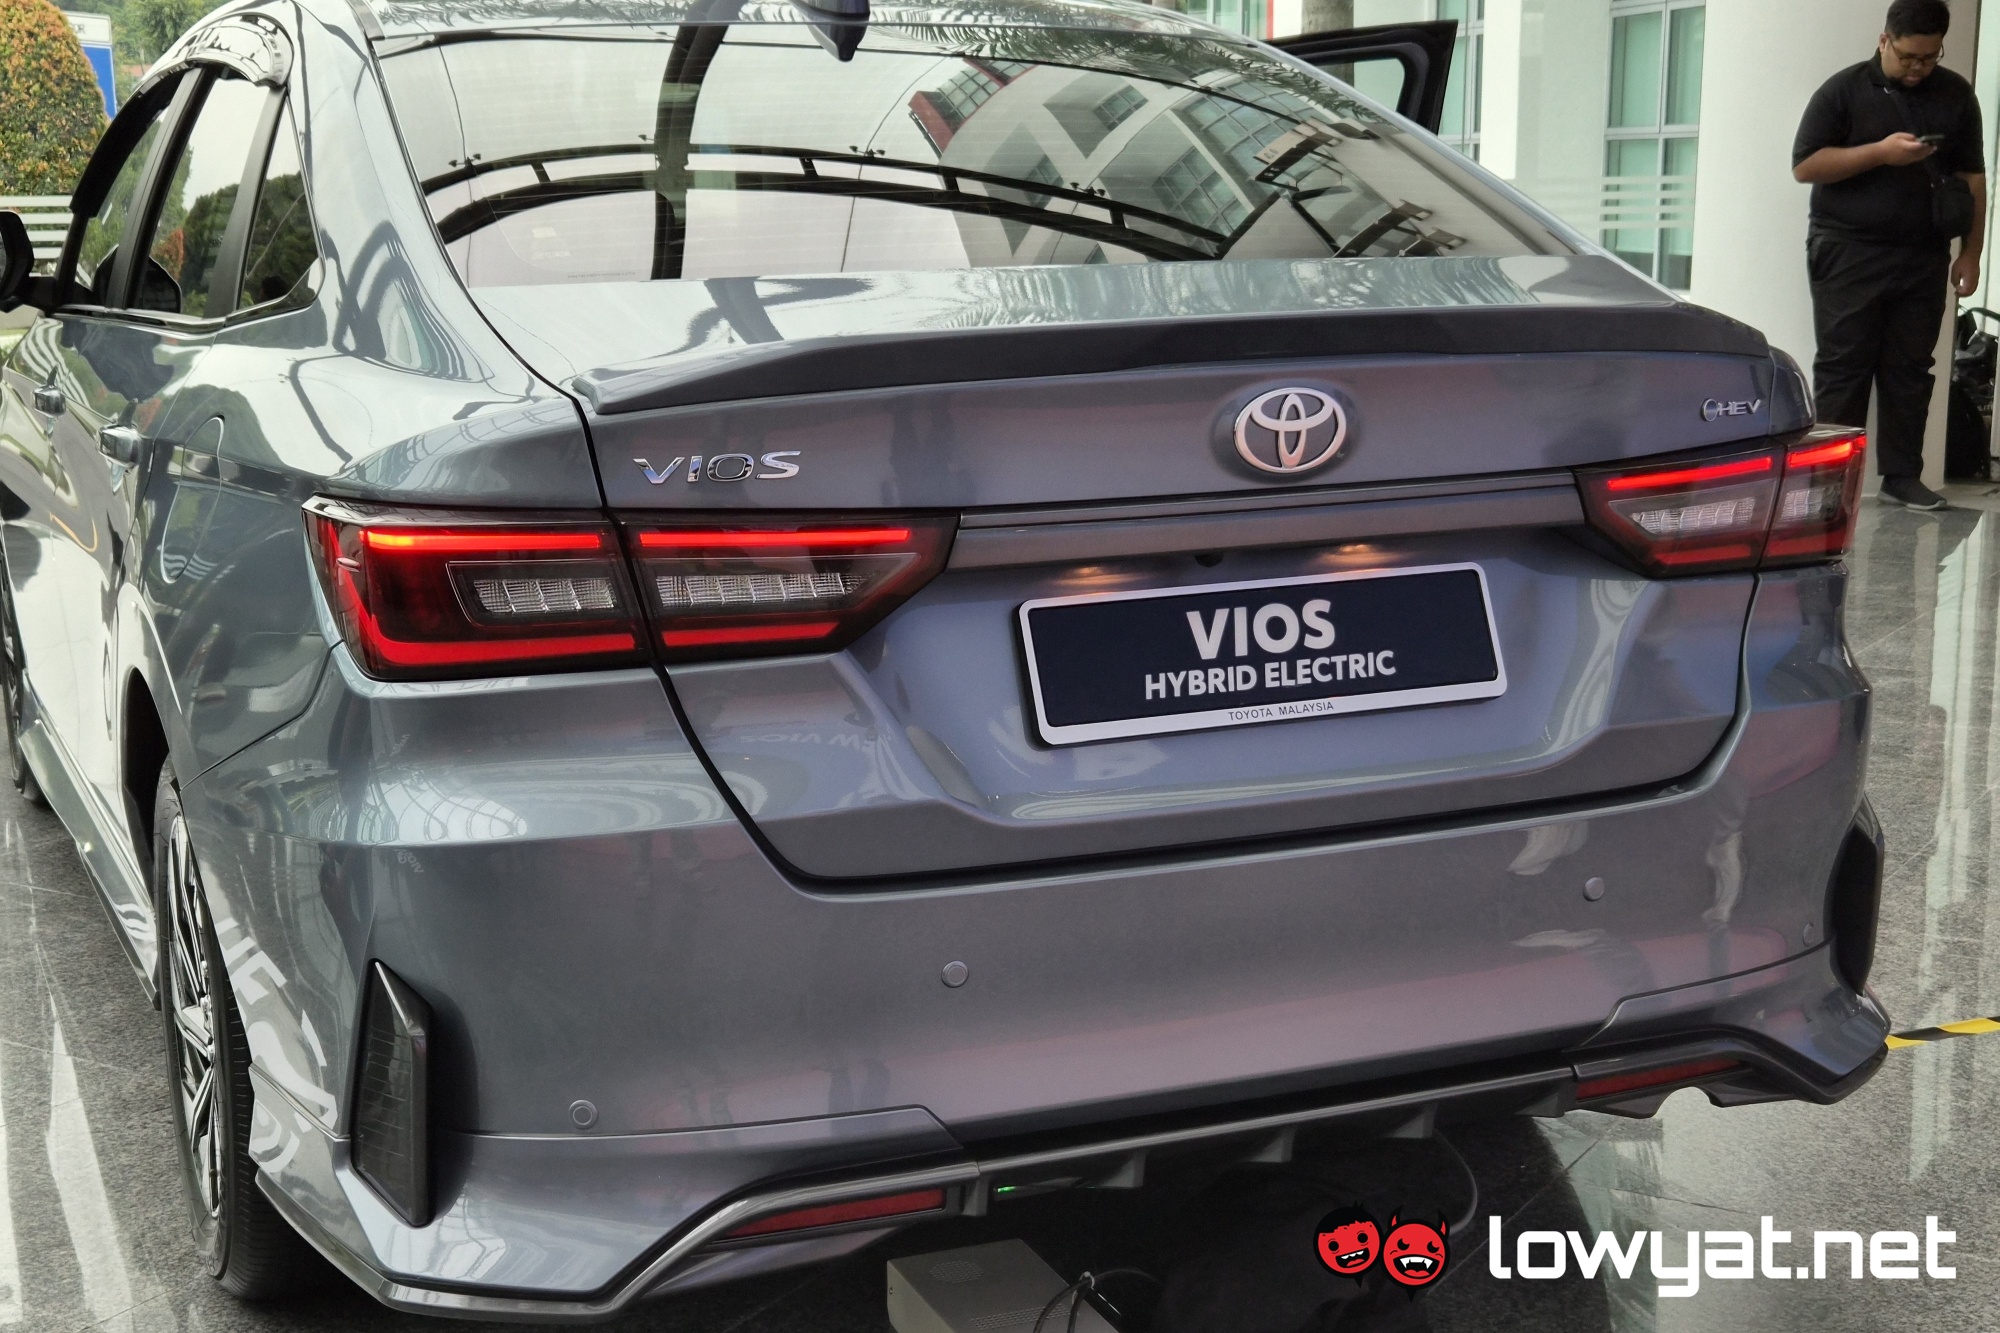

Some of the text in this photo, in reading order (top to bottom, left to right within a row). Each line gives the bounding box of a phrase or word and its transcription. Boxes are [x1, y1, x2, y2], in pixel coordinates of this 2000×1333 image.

[633, 450, 801, 484] VIOS
[1186, 599, 1336, 660] VIOS
[1145, 650, 1397, 700] HYBRID ELECTRIC
[1228, 701, 1334, 721] TOYOTA MALAYSIA
